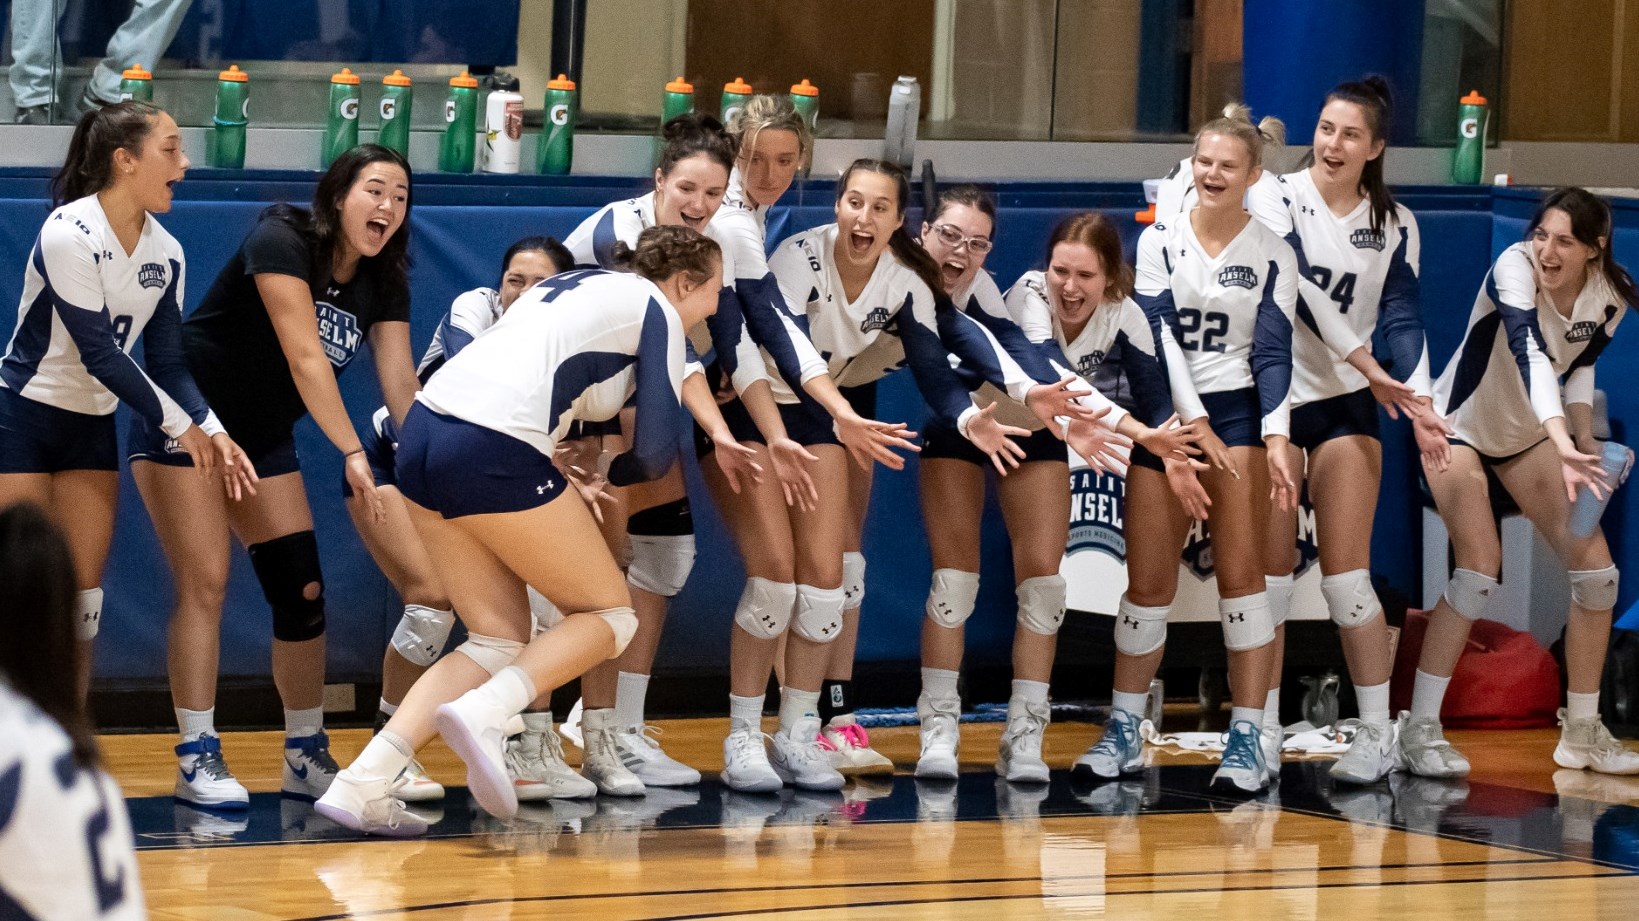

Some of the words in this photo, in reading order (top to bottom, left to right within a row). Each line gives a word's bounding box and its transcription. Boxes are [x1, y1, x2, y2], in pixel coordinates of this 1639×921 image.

[340, 98, 358, 120] G
[380, 98, 395, 119] G
[551, 104, 568, 126] G
[1460, 118, 1478, 139] G
[314, 305, 350, 328] AINT
[317, 317, 359, 353] SELM
[1178, 307, 1230, 354] 22
[1069, 492, 1124, 530] NSEL
